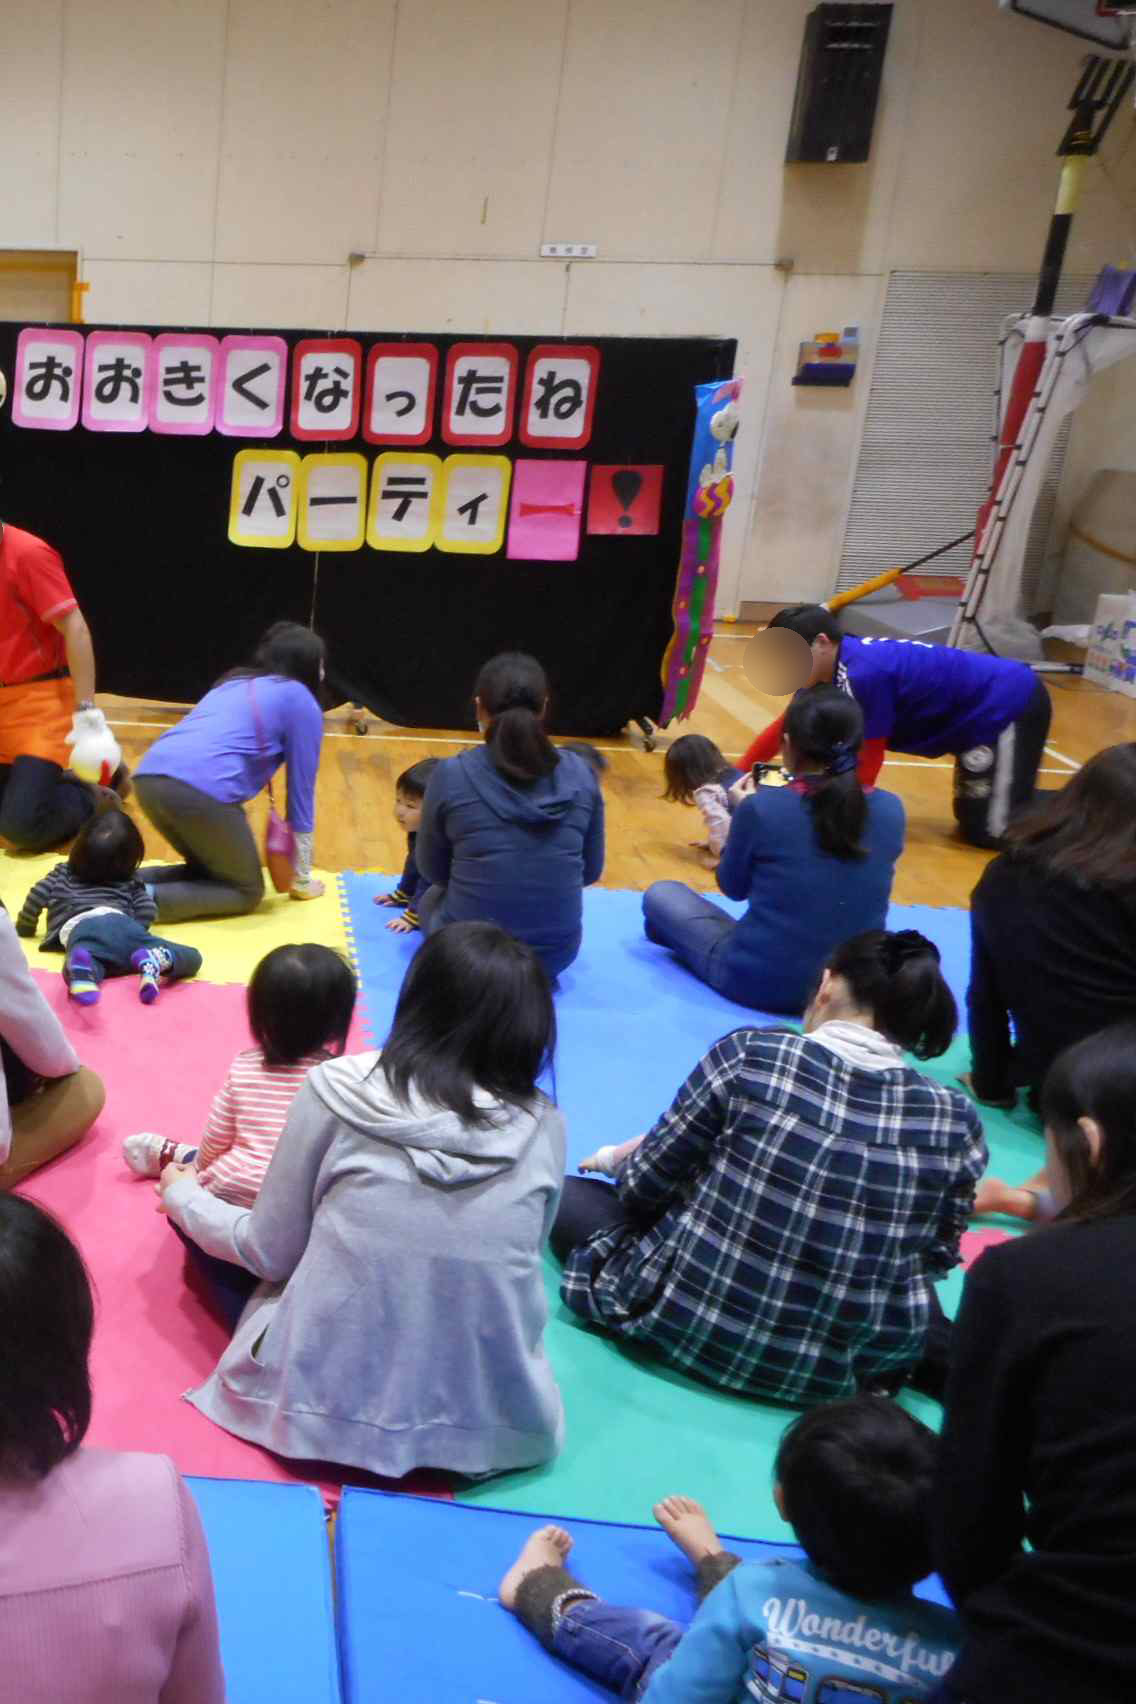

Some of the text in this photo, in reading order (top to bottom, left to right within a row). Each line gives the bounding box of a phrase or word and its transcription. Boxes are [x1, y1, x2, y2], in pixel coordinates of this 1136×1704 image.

[25, 355, 584, 420] おおきくなったね
[763, 1597, 956, 1677] Wonderful
